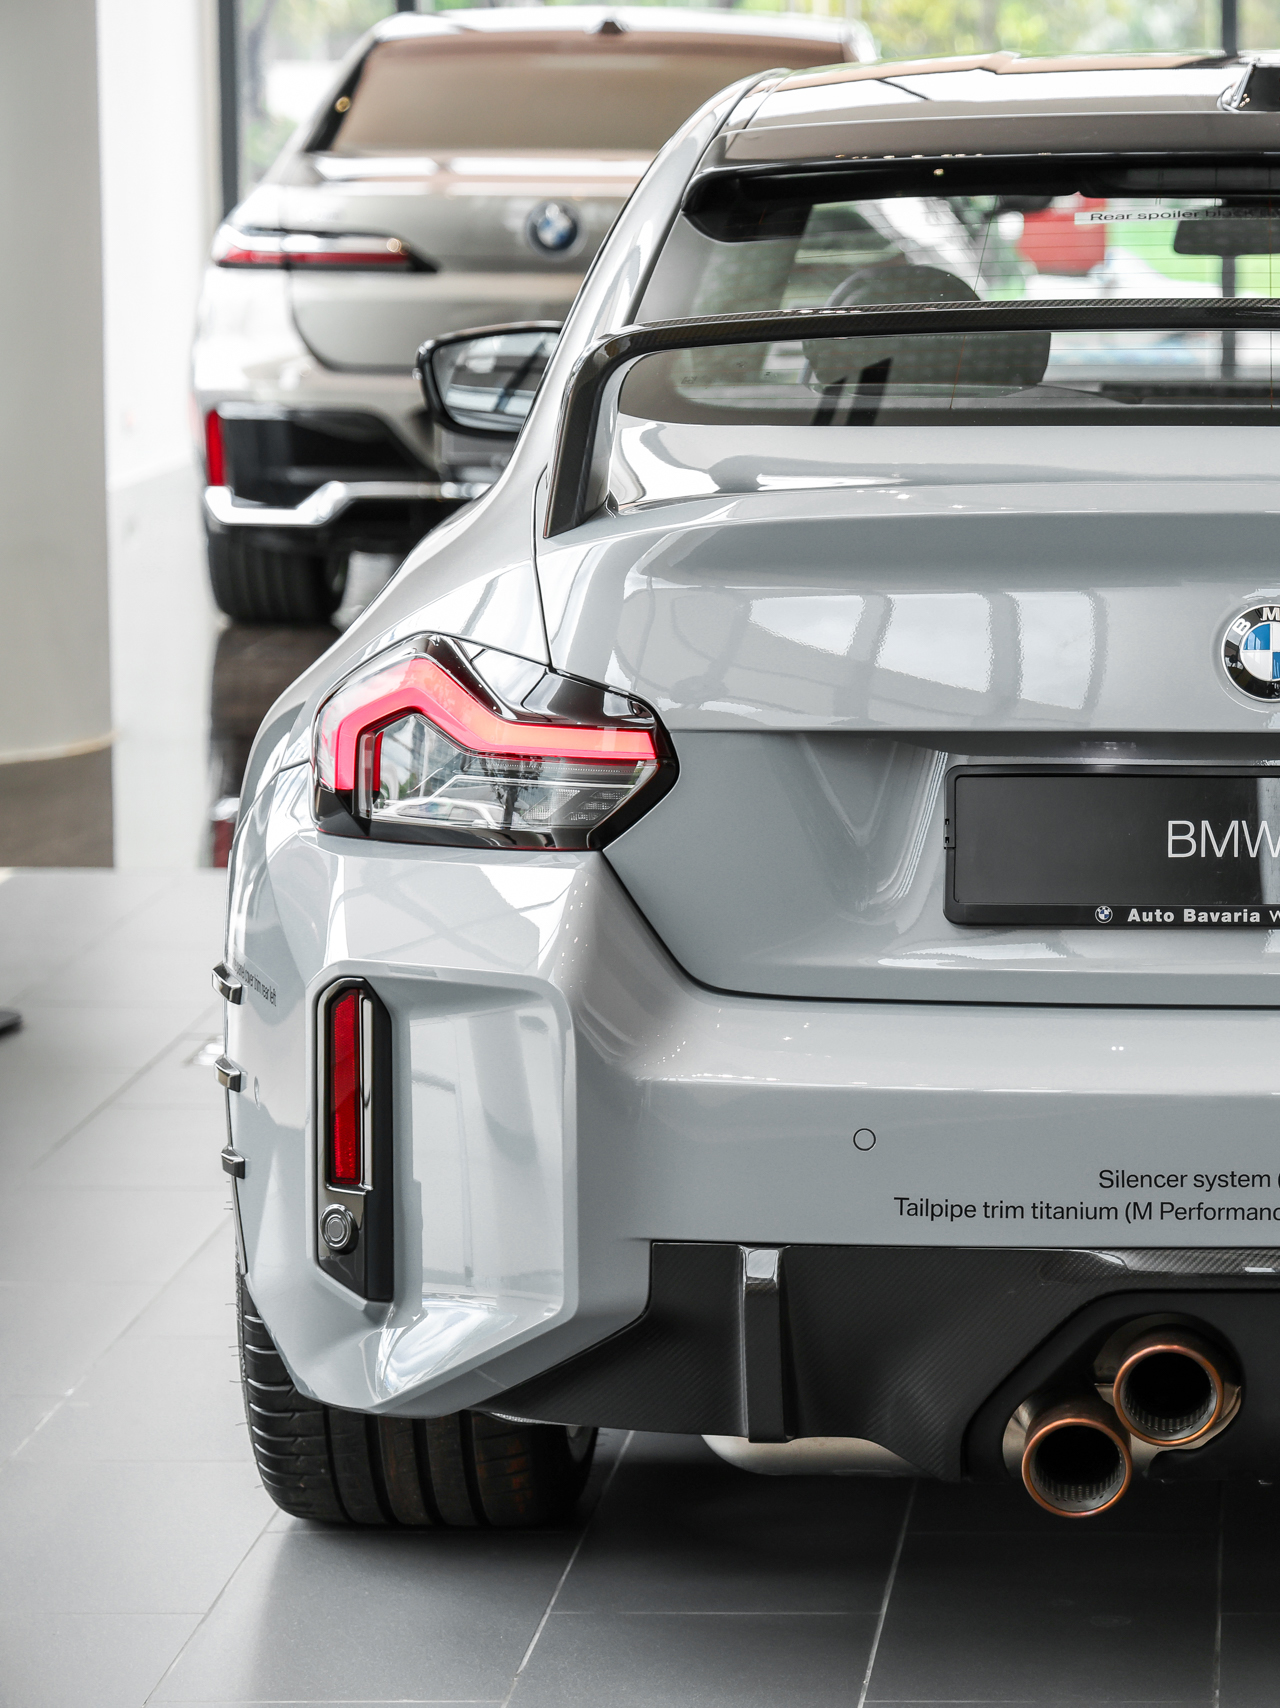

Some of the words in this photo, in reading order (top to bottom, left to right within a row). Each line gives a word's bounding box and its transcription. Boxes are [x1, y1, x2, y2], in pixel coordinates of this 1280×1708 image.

[1089, 212, 1133, 222] Rear
[1137, 207, 1199, 222] spoiler
[1127, 907, 1175, 923] Auto
[1183, 907, 1261, 923] Bavaria
[1098, 1169, 1189, 1189] Silencer
[1193, 1170, 1271, 1192] system
[893, 1196, 977, 1222] Tailpipe
[982, 1200, 1025, 1220] trim
[1030, 1200, 1119, 1221] titanium
[1124, 1201, 1153, 1225] (M
